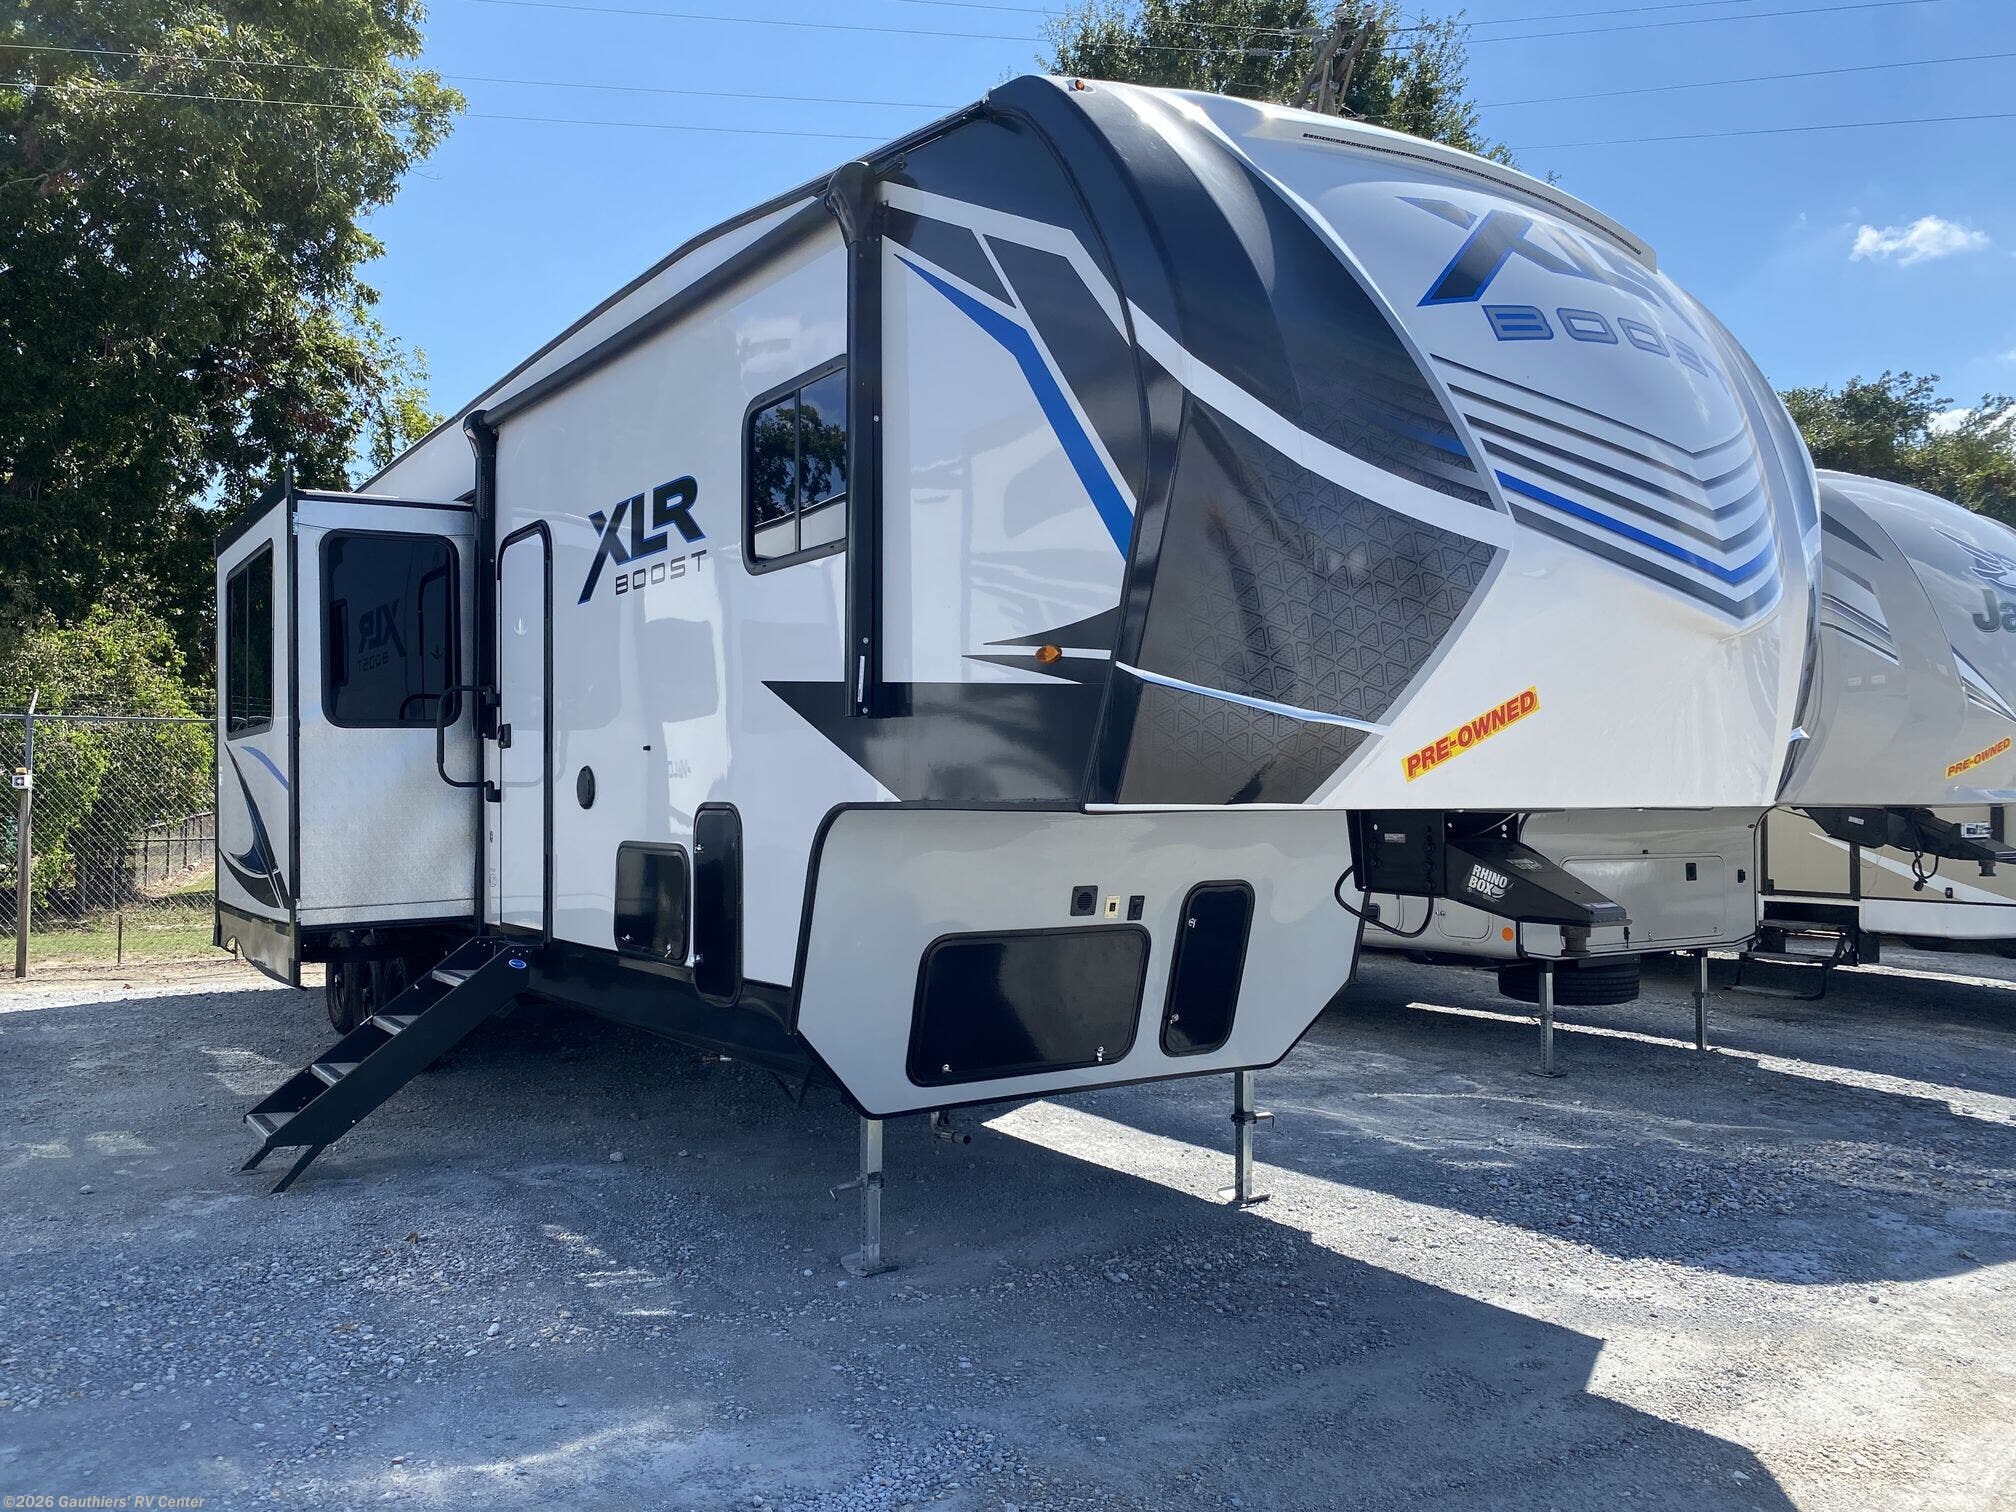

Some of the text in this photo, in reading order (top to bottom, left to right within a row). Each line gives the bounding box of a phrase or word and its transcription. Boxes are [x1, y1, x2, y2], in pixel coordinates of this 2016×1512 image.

[577, 475, 706, 605] XLR
[615, 549, 707, 596] BOOST
[1406, 690, 1538, 779] PRE-OWNED
[1947, 737, 2011, 777] PRE-OWNED
[1468, 875, 1493, 896] BOX
[1472, 863, 1508, 888] RHINO
